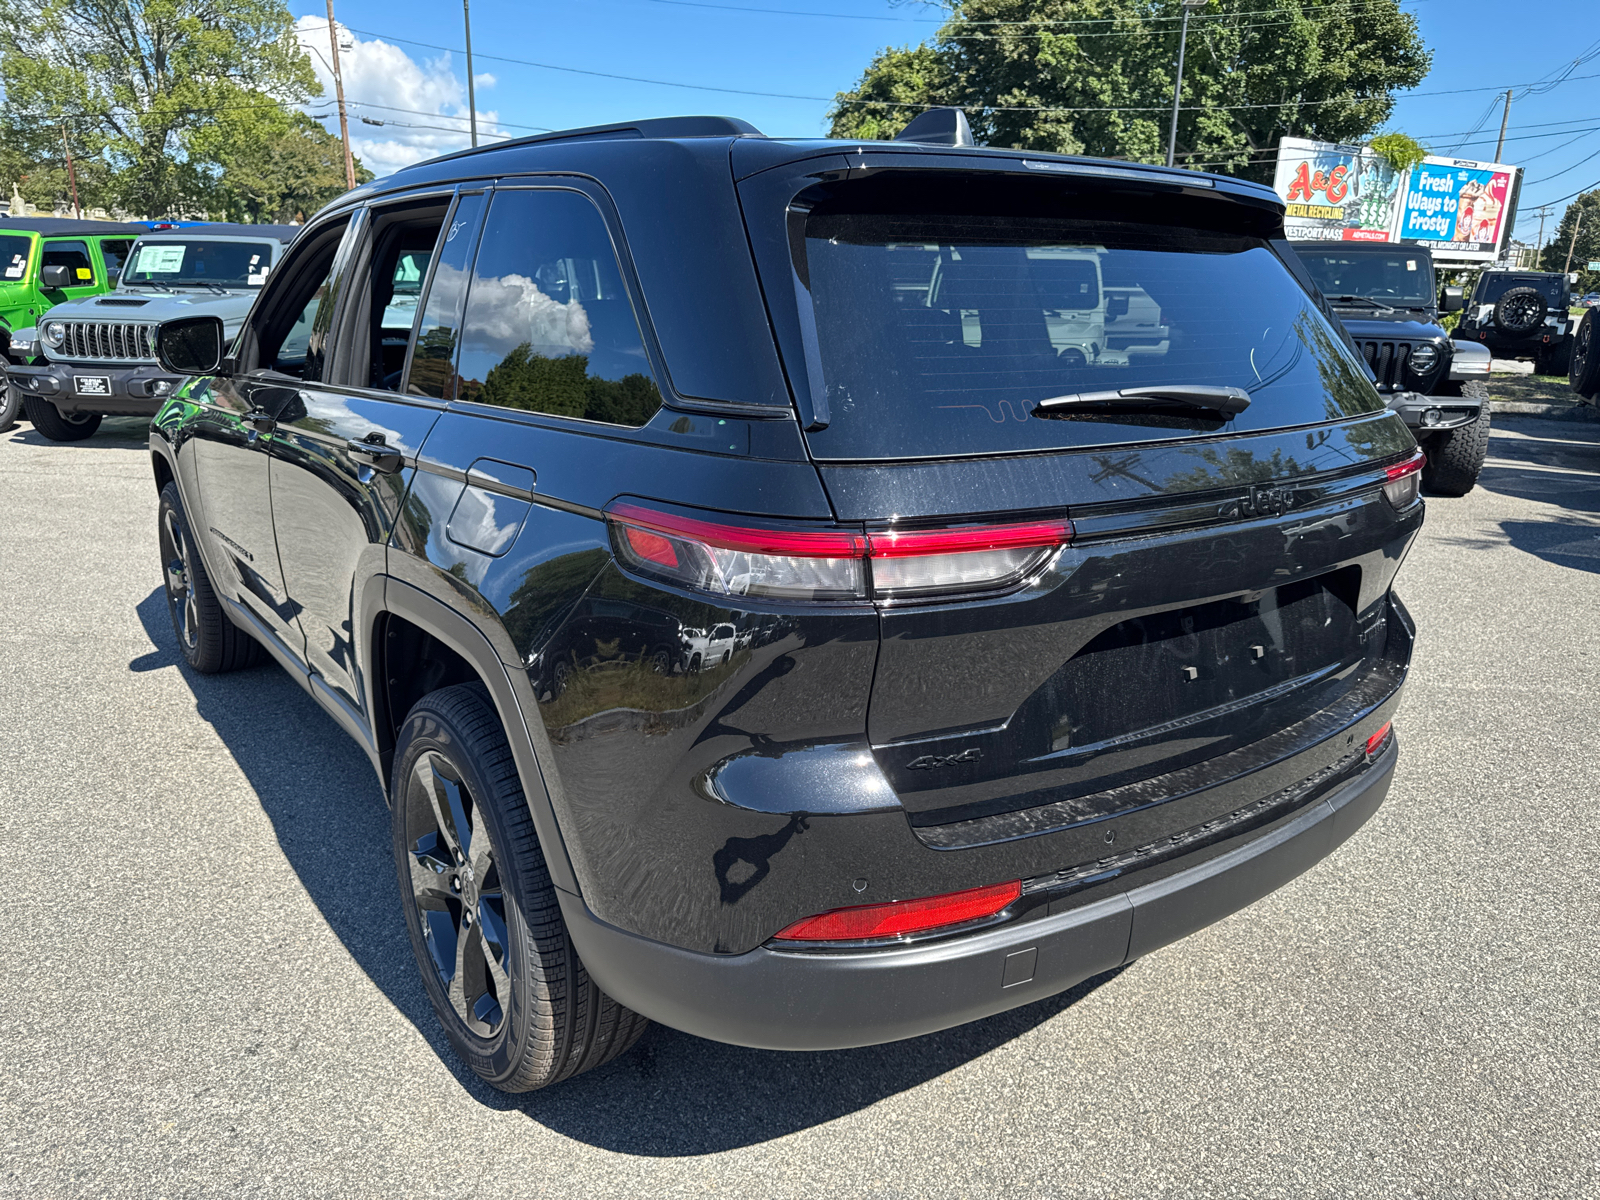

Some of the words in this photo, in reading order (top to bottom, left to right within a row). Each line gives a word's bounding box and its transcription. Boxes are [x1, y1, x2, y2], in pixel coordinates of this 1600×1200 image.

[1286, 160, 1349, 205] A&E
[1418, 171, 1454, 193] Fresh
[1285, 203, 1309, 217] METAL
[1308, 205, 1345, 220] RECYCLING
[1407, 190, 1443, 216] Ways
[1443, 195, 1458, 213] to
[1323, 228, 1344, 241] MASS
[1408, 211, 1451, 237] Frosty
